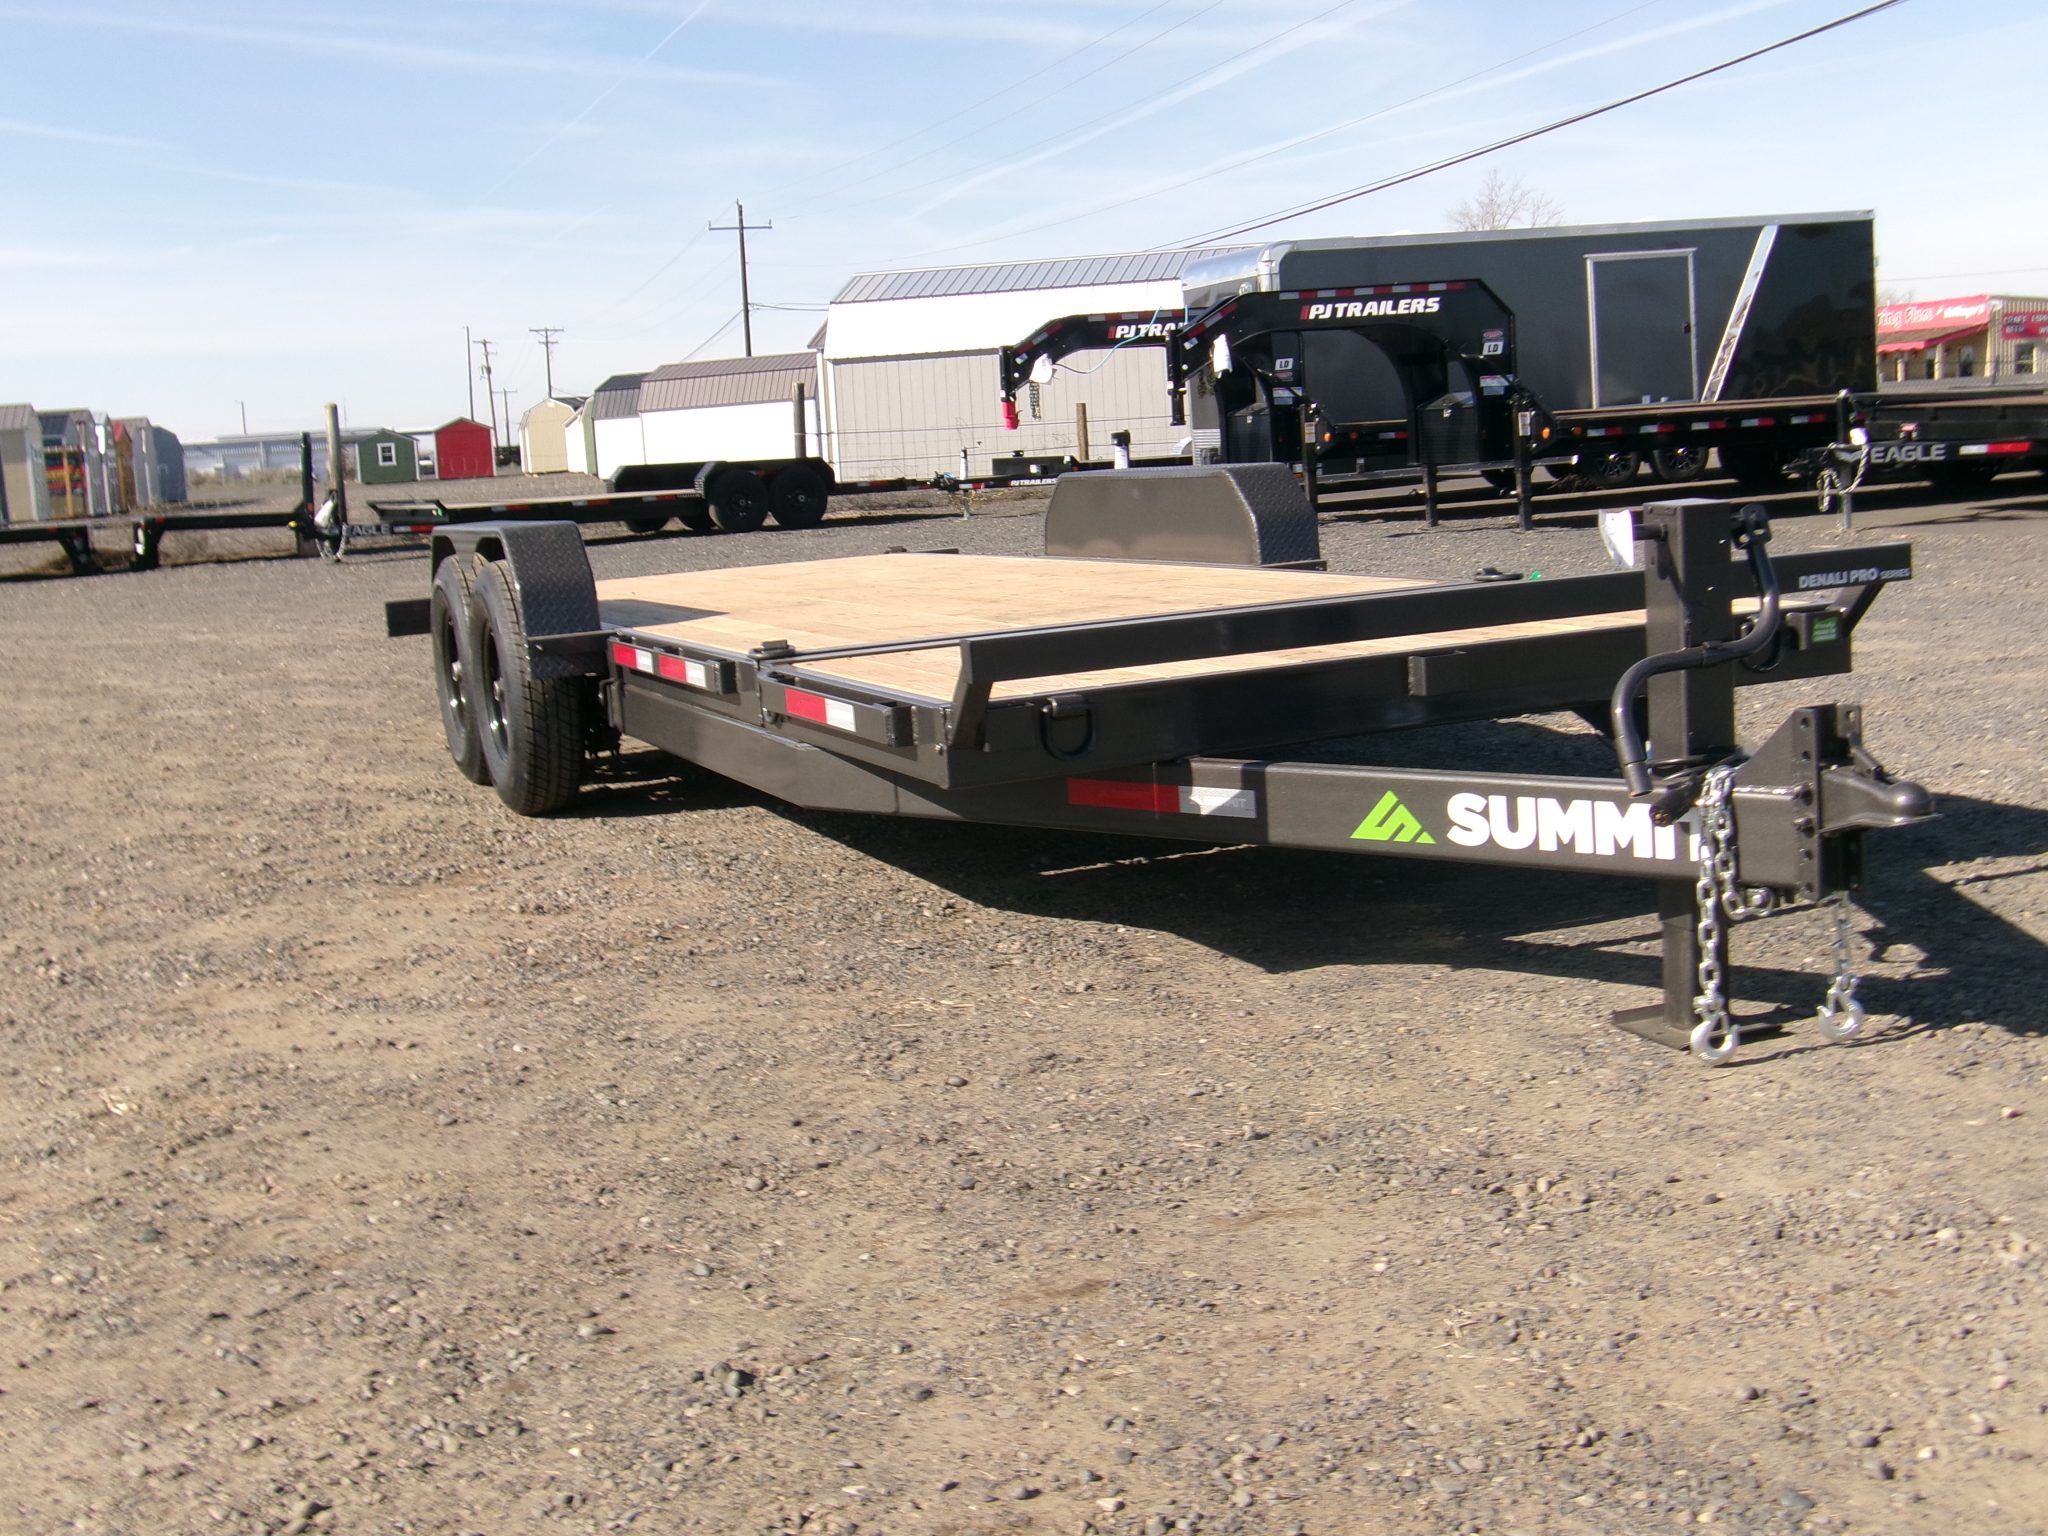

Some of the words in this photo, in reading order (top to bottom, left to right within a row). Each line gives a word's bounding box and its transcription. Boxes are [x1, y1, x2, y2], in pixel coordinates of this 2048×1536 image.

[1309, 304, 1332, 319] PJ
[1334, 297, 1440, 318] TRAILERS
[1115, 325, 1136, 338] PJ
[1138, 322, 1184, 337] TRA
[1871, 444, 1946, 463] EAGLE
[1799, 571, 1848, 589] DENALI
[1849, 567, 1878, 583] PRO
